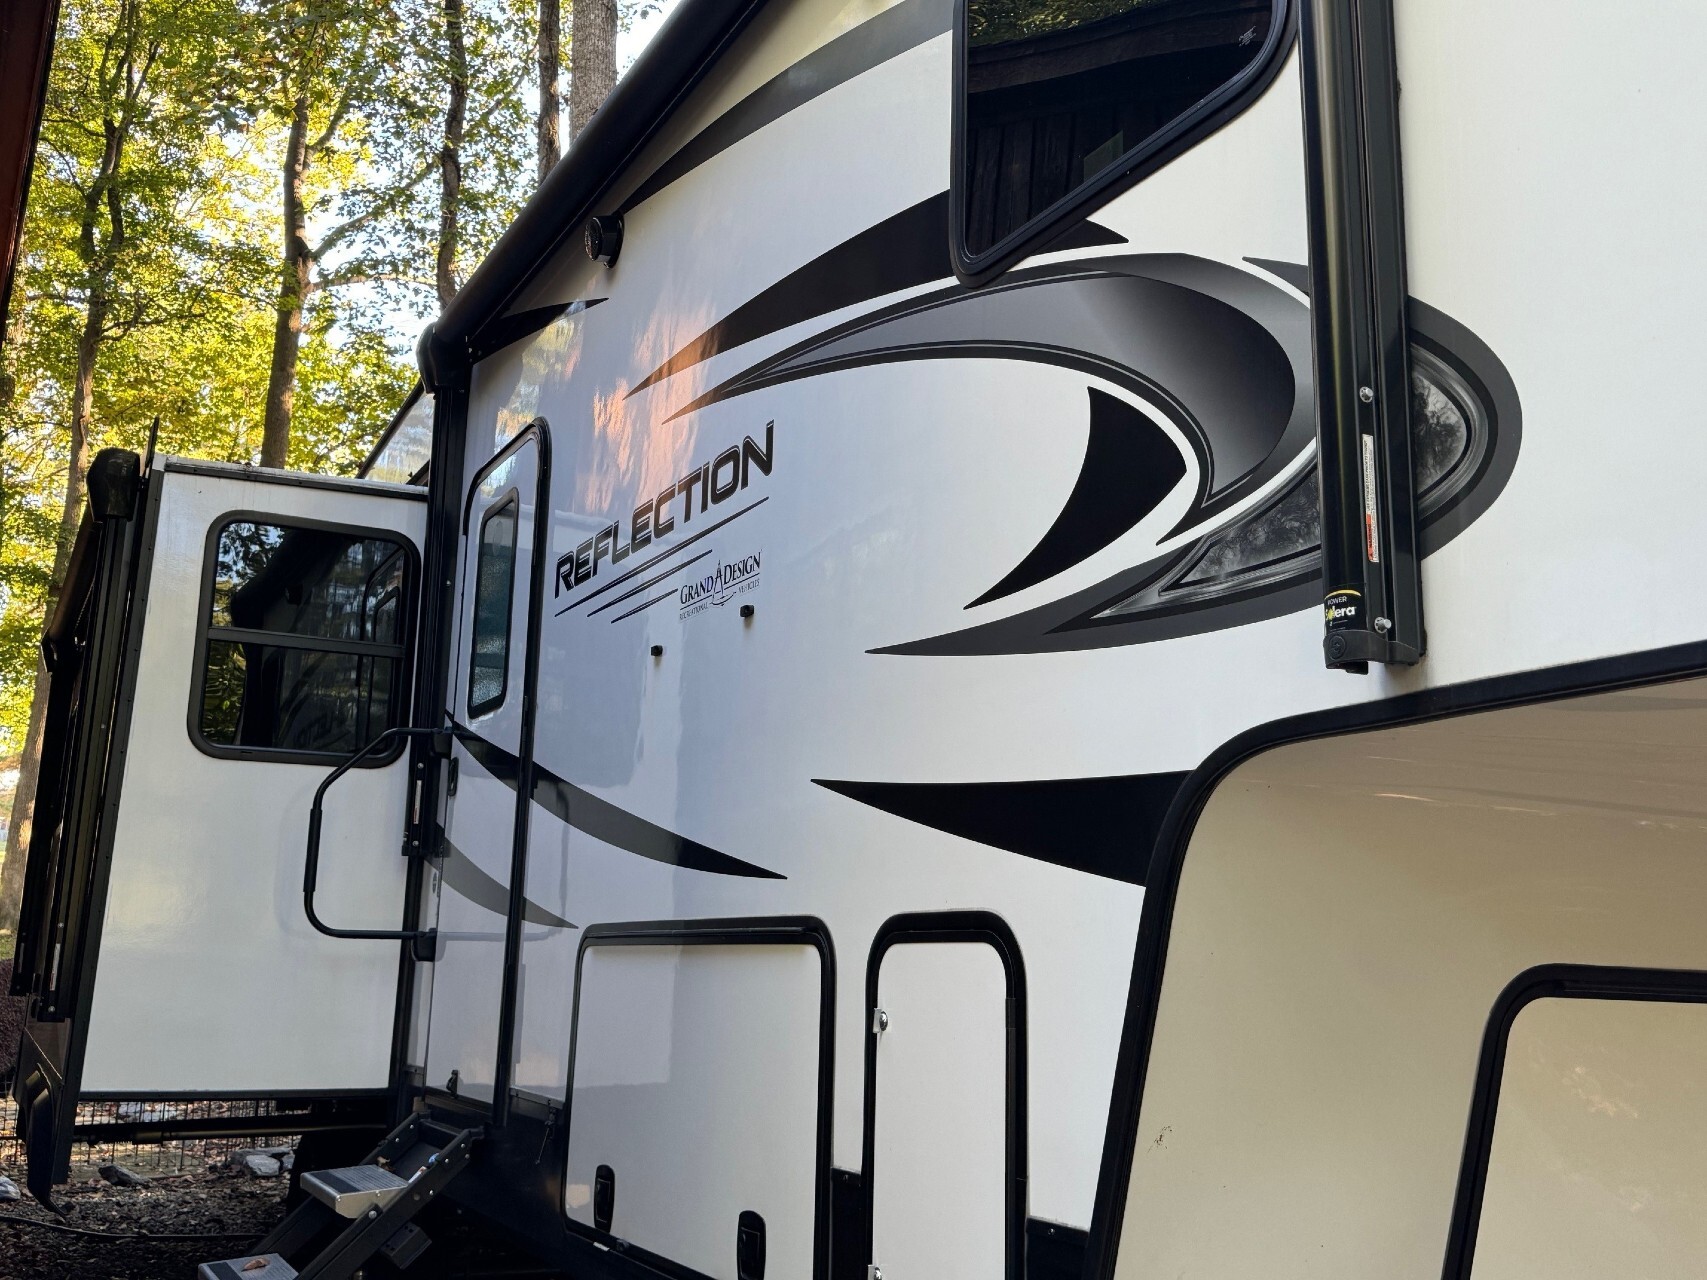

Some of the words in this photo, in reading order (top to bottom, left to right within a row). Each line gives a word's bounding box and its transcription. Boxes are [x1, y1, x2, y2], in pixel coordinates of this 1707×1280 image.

[554, 420, 774, 599] REFLECTION
[680, 575, 714, 604] GRAND
[724, 552, 761, 589] DESIGN
